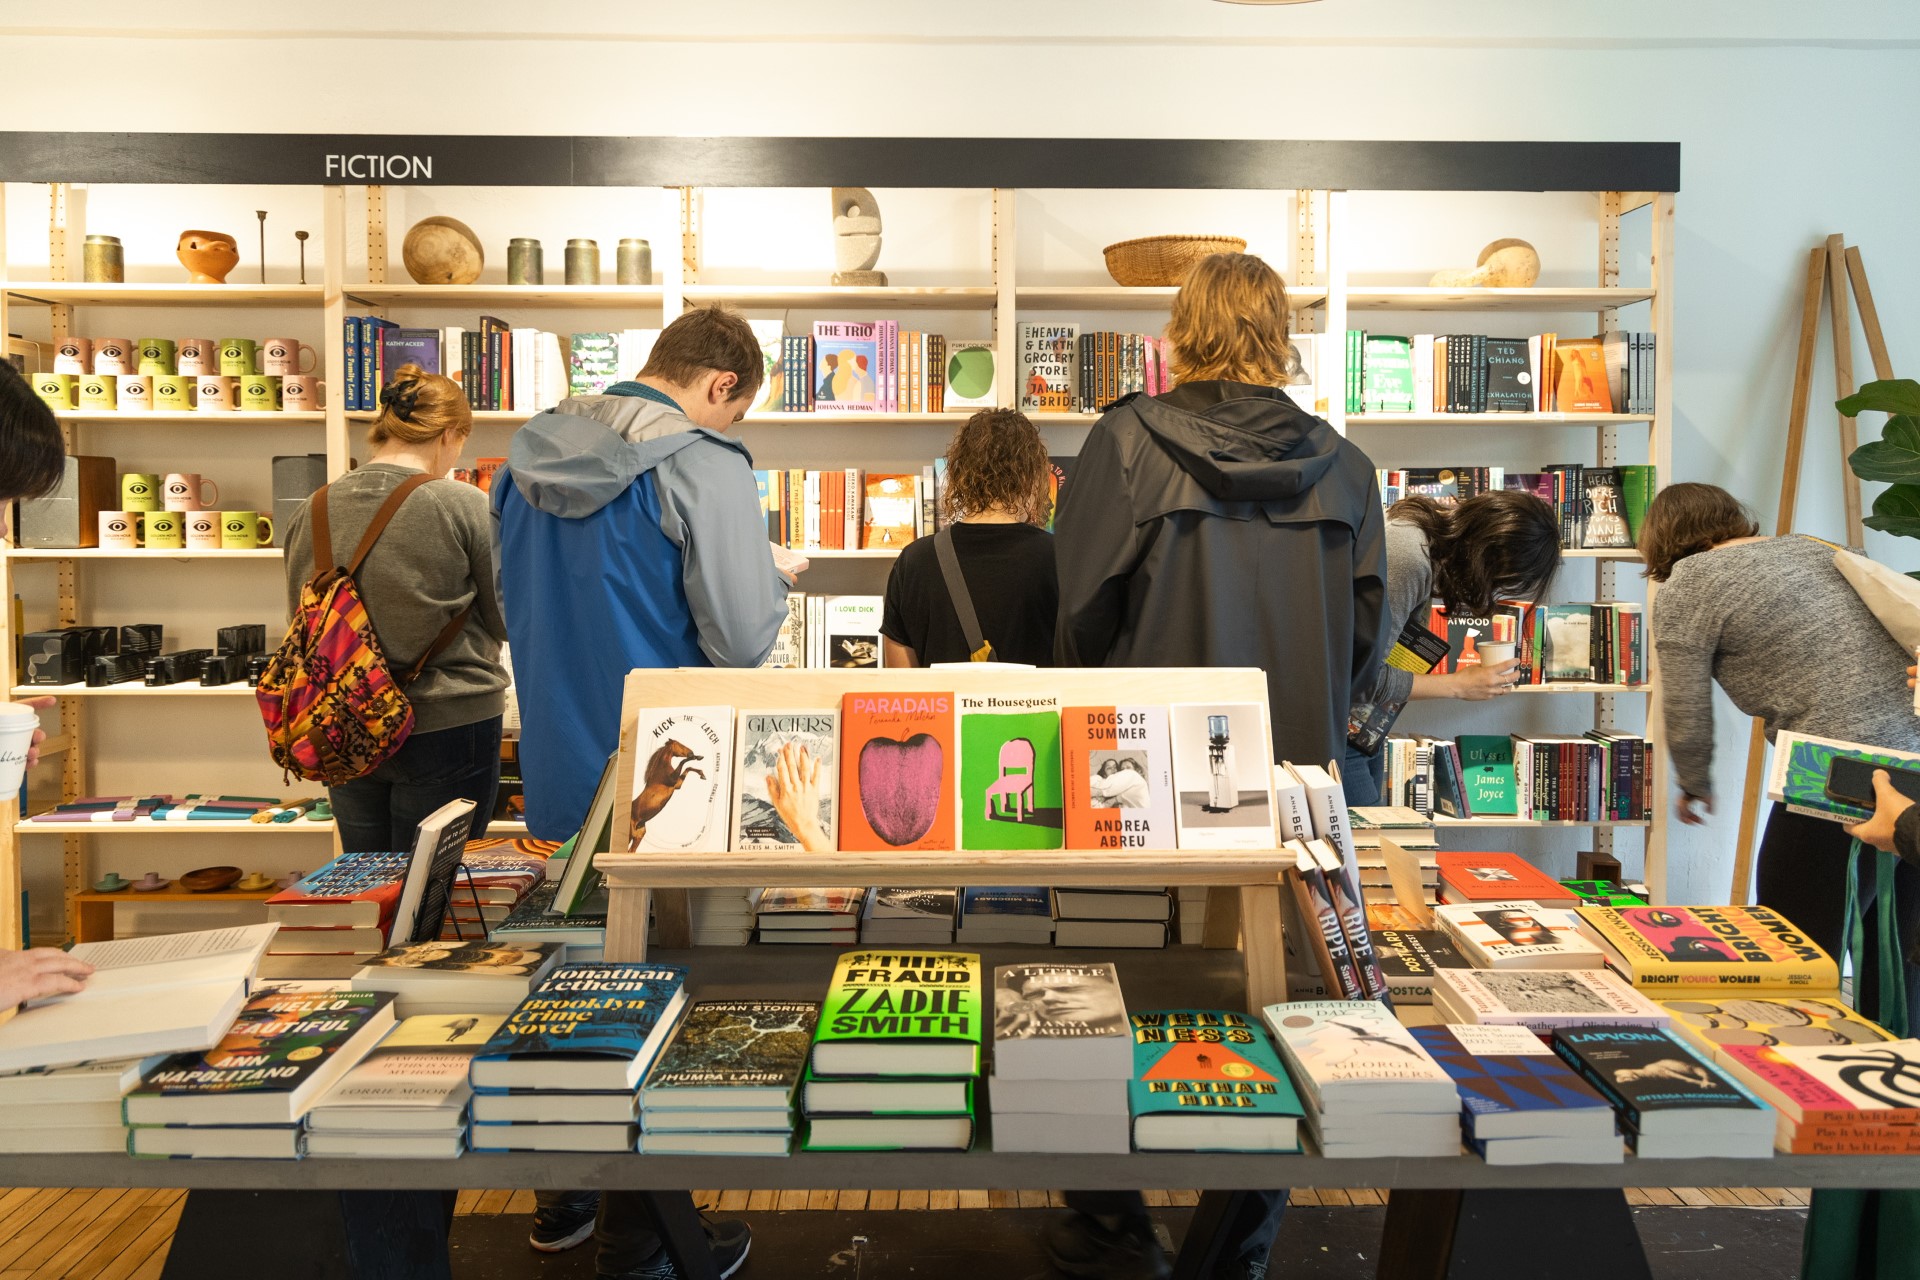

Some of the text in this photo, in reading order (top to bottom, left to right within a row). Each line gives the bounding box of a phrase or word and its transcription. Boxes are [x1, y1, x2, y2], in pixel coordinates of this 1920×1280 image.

[325, 154, 433, 179] FICTION
[817, 324, 873, 337] THE TRIO
[1032, 327, 1074, 338] HEAVEN
[1025, 340, 1074, 350] & EARTH
[1024, 353, 1075, 364] GROCERY
[1031, 366, 1068, 376] STORE
[347, 358, 356, 400] Family Lore
[363, 358, 372, 400] Family Lore
[1030, 384, 1069, 394] JAMES
[1022, 396, 1077, 407] McBRIDE
[1588, 475, 1615, 485] HEAR
[1408, 484, 1444, 494] NIGHT
[1583, 488, 1617, 498] OU'RE
[1583, 500, 1617, 514] RICH
[1586, 524, 1623, 535] DIANE
[1586, 536, 1625, 544] WILLIAMS
[1448, 618, 1490, 626] ATWOOD
[854, 698, 948, 714] PARADAIS
[962, 697, 1057, 708] The Houseguest
[869, 711, 936, 725] Fernanda Melchor
[1087, 713, 1146, 725] DOGS OF
[653, 717, 675, 738] KICK
[701, 723, 720, 745] LATCH
[748, 718, 832, 732] GLACIERS
[1088, 728, 1147, 739] SUMMER
[1470, 750, 1505, 763] Ulysses
[1474, 775, 1505, 786] James
[709, 784, 718, 803] SCANLAN
[1477, 789, 1504, 802] Joyce
[1290, 795, 1298, 814] ANNE
[1794, 806, 1828, 818] OUTLINE
[1094, 820, 1150, 832] ANDREA
[1100, 836, 1145, 847] ABREU
[1599, 908, 1630, 930] KNOLL
[1687, 907, 1773, 962] BRIGHT
[1738, 907, 1822, 962] WOMEN
[1405, 934, 1426, 953] BEREST
[1626, 932, 1664, 962] JESSICA
[1319, 915, 1355, 996] RIPE Sarah
[1344, 914, 1380, 996] RIPE Sarah
[1382, 931, 1425, 972] POSTCARD
[1498, 946, 1565, 957] Patrick
[874, 956, 944, 968] THE
[547, 968, 674, 982] Jonathan
[845, 970, 970, 983] FRAUD
[1003, 968, 1105, 978] A LITTLE
[1641, 975, 1679, 984] BRIGHT
[1719, 976, 1760, 984] WOMEN
[537, 980, 644, 992] Lethem
[1030, 976, 1080, 984] LIFE
[1579, 971, 1606, 990] Laing
[1388, 987, 1432, 996] POSTCA
[267, 1000, 349, 1013] HELLO
[521, 998, 646, 1011] Brooklyn
[694, 1004, 747, 1012] ROMAN
[836, 989, 970, 1015] ZADIE
[1275, 1002, 1377, 1012] LIBERATION
[1607, 991, 1639, 1014] Olivia
[510, 1009, 594, 1022] Crime
[1131, 1014, 1248, 1028] WELL
[225, 1020, 351, 1034] EAUTIFUL
[503, 1022, 578, 1035] Novel
[830, 1016, 969, 1034] SMITH
[1003, 1027, 1117, 1036] YANAGIHARA
[1517, 1022, 1558, 1030] Weather
[1136, 1028, 1251, 1044] NESS
[1569, 1033, 1667, 1044] LAPVONA
[213, 1055, 270, 1068] ANN
[1555, 1040, 1581, 1070] LAPVONA
[150, 1066, 300, 1084] NAPOLITANO
[1332, 1070, 1435, 1080] SAUNDERS
[1148, 1082, 1277, 1094] NATHAN
[1178, 1095, 1257, 1108] HILL
